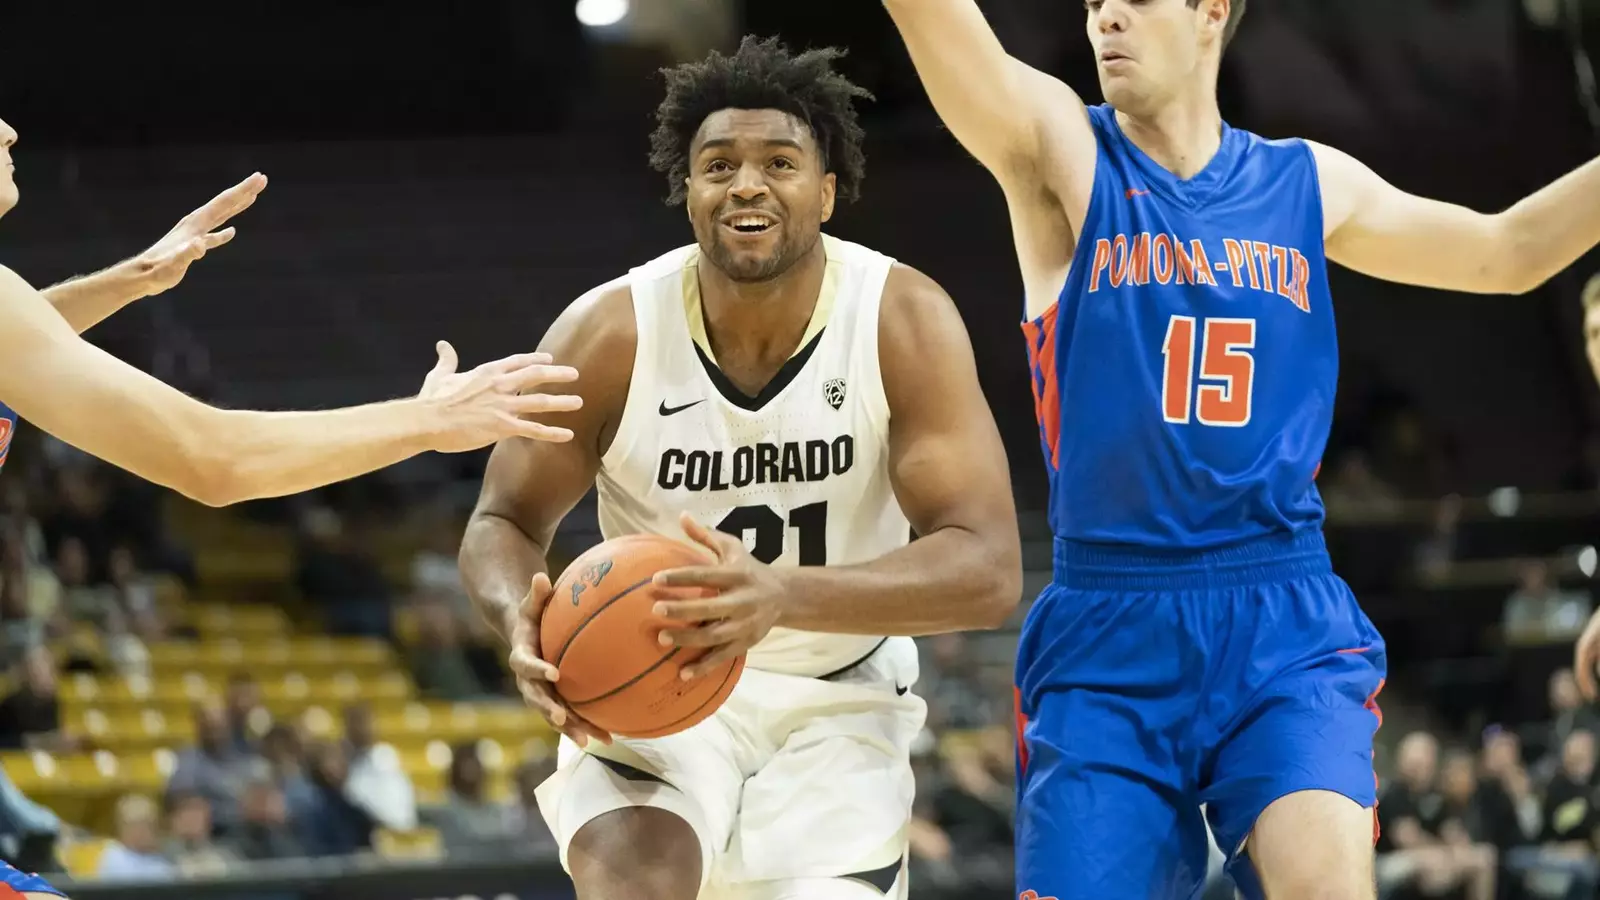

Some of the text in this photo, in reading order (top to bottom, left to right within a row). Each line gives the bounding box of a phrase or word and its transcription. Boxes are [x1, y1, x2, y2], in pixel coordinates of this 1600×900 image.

[824, 378, 846, 399] PAC
[1161, 314, 1256, 428] 15
[829, 391, 842, 405] 12
[657, 434, 854, 491] COLORADO
